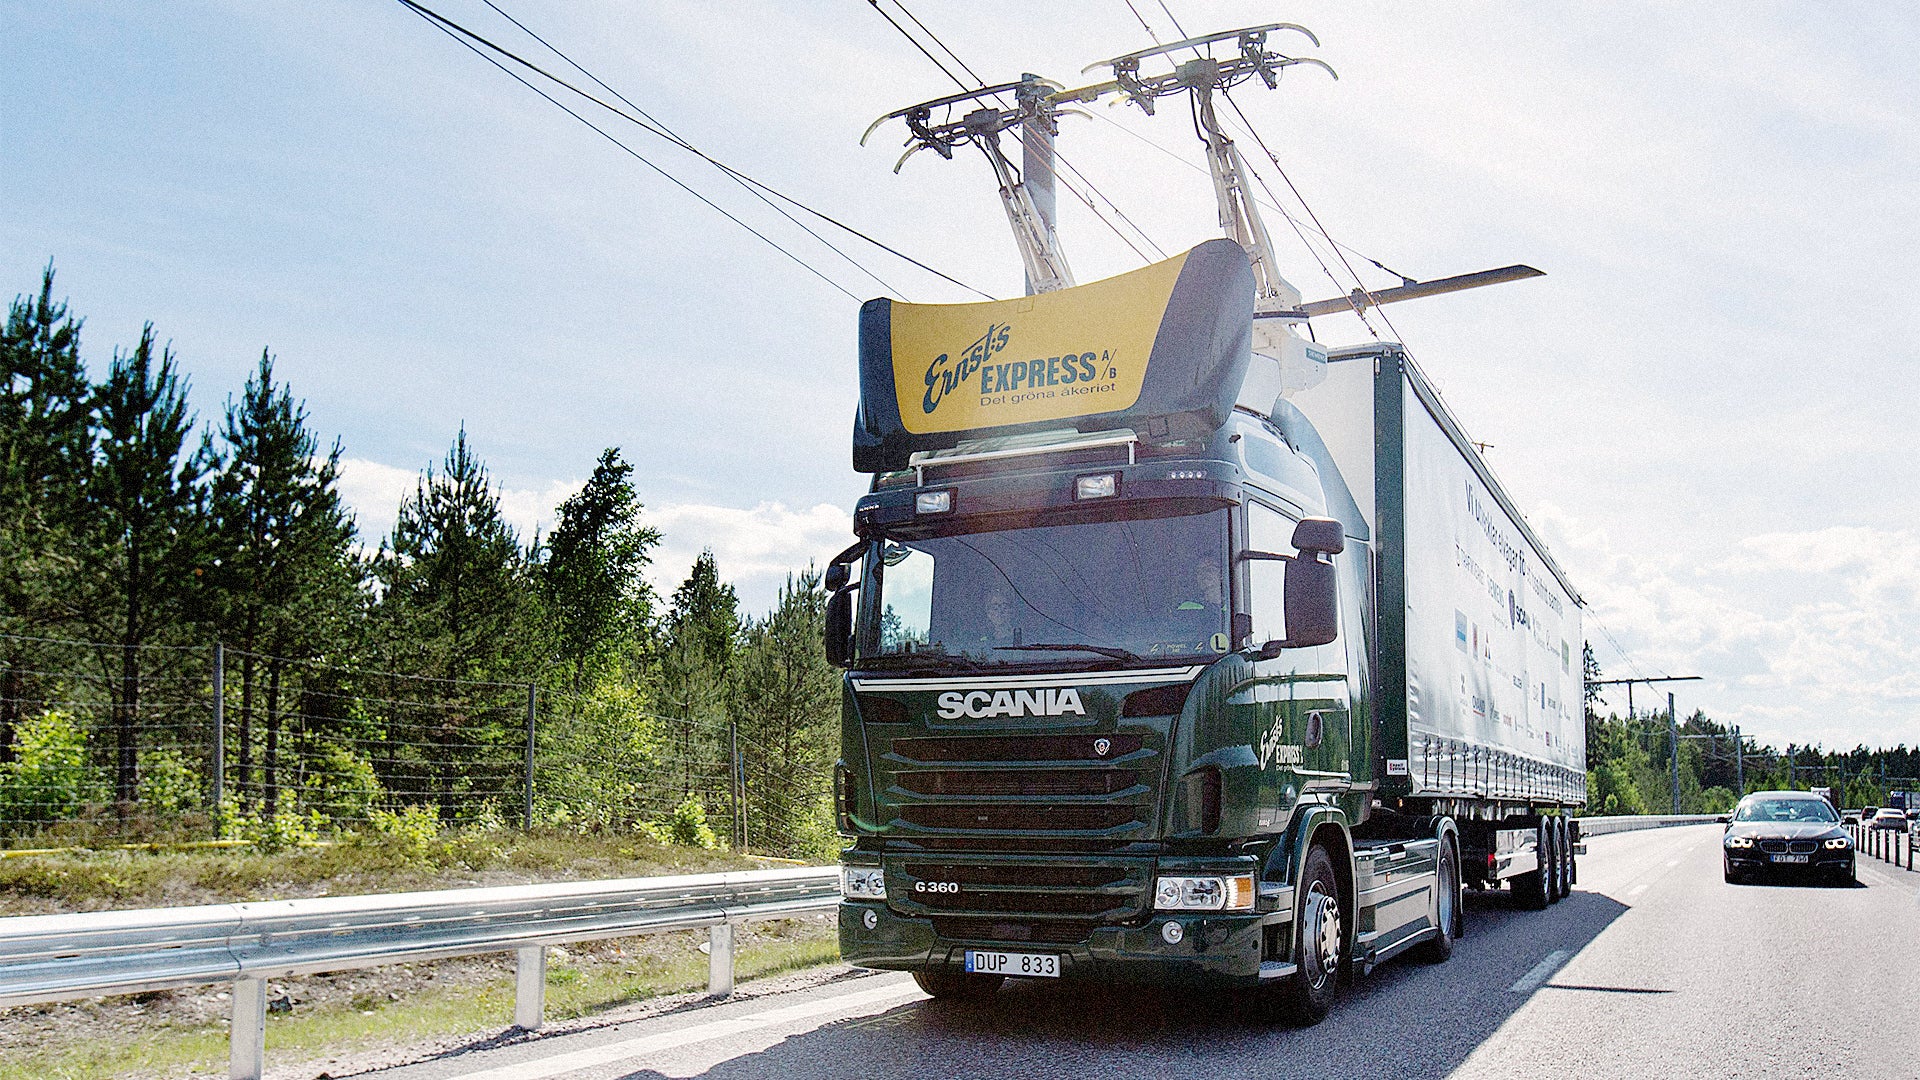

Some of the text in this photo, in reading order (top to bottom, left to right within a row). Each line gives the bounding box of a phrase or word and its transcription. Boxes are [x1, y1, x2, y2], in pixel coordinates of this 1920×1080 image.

[981, 352, 1096, 394] EXPRESS
[980, 383, 1116, 406] Det gröna åkeriet
[1215, 635, 1226, 650] L
[937, 688, 1086, 719] SCANIA
[1276, 745, 1300, 763] EXPRESS
[976, 953, 1055, 974] DUP 833
